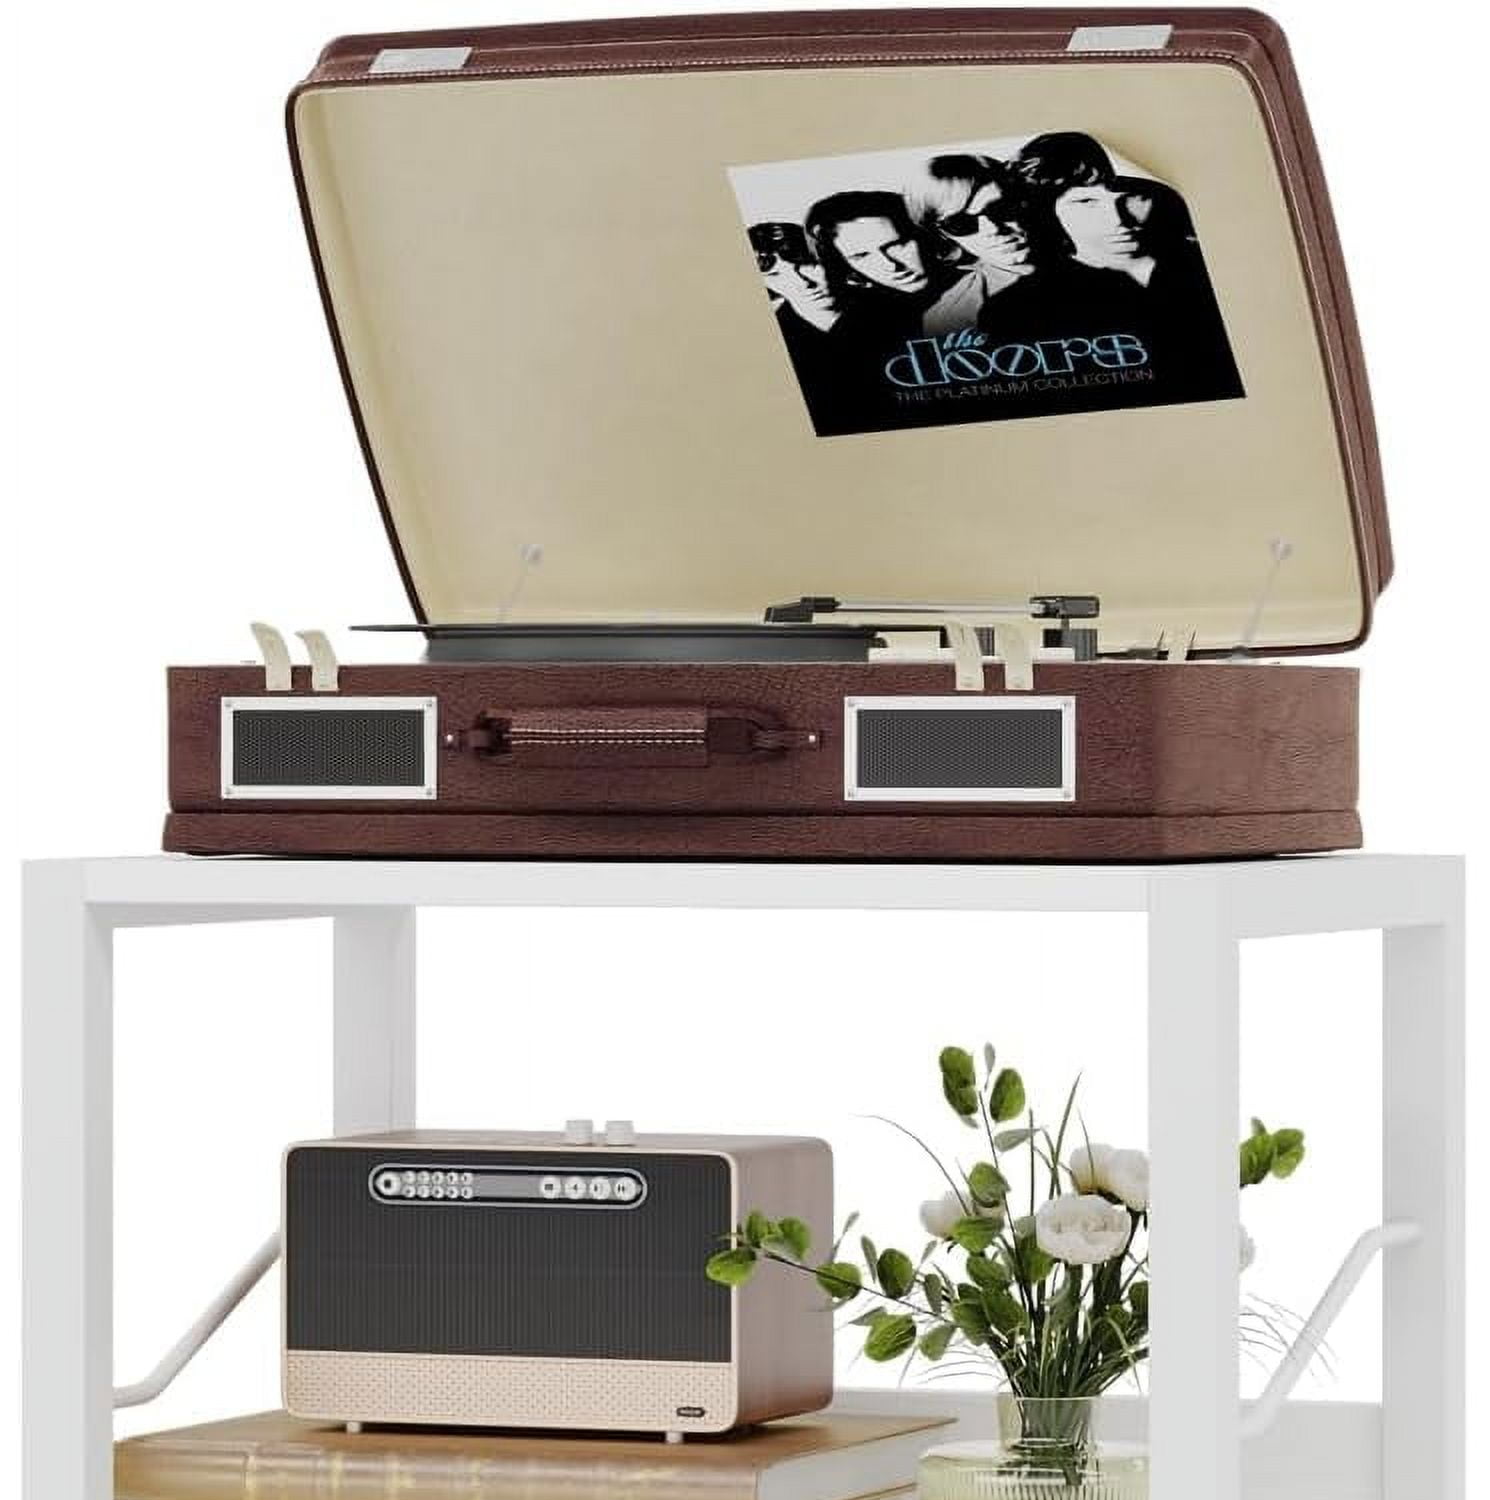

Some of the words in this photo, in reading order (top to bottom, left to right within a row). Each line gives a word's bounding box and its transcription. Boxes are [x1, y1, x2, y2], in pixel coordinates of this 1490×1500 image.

[943, 327, 988, 349] the
[885, 334, 1148, 387] doors
[896, 388, 931, 402] THE
[935, 380, 1030, 399] PLATINUM
[1033, 368, 1153, 392] COLLECTION
